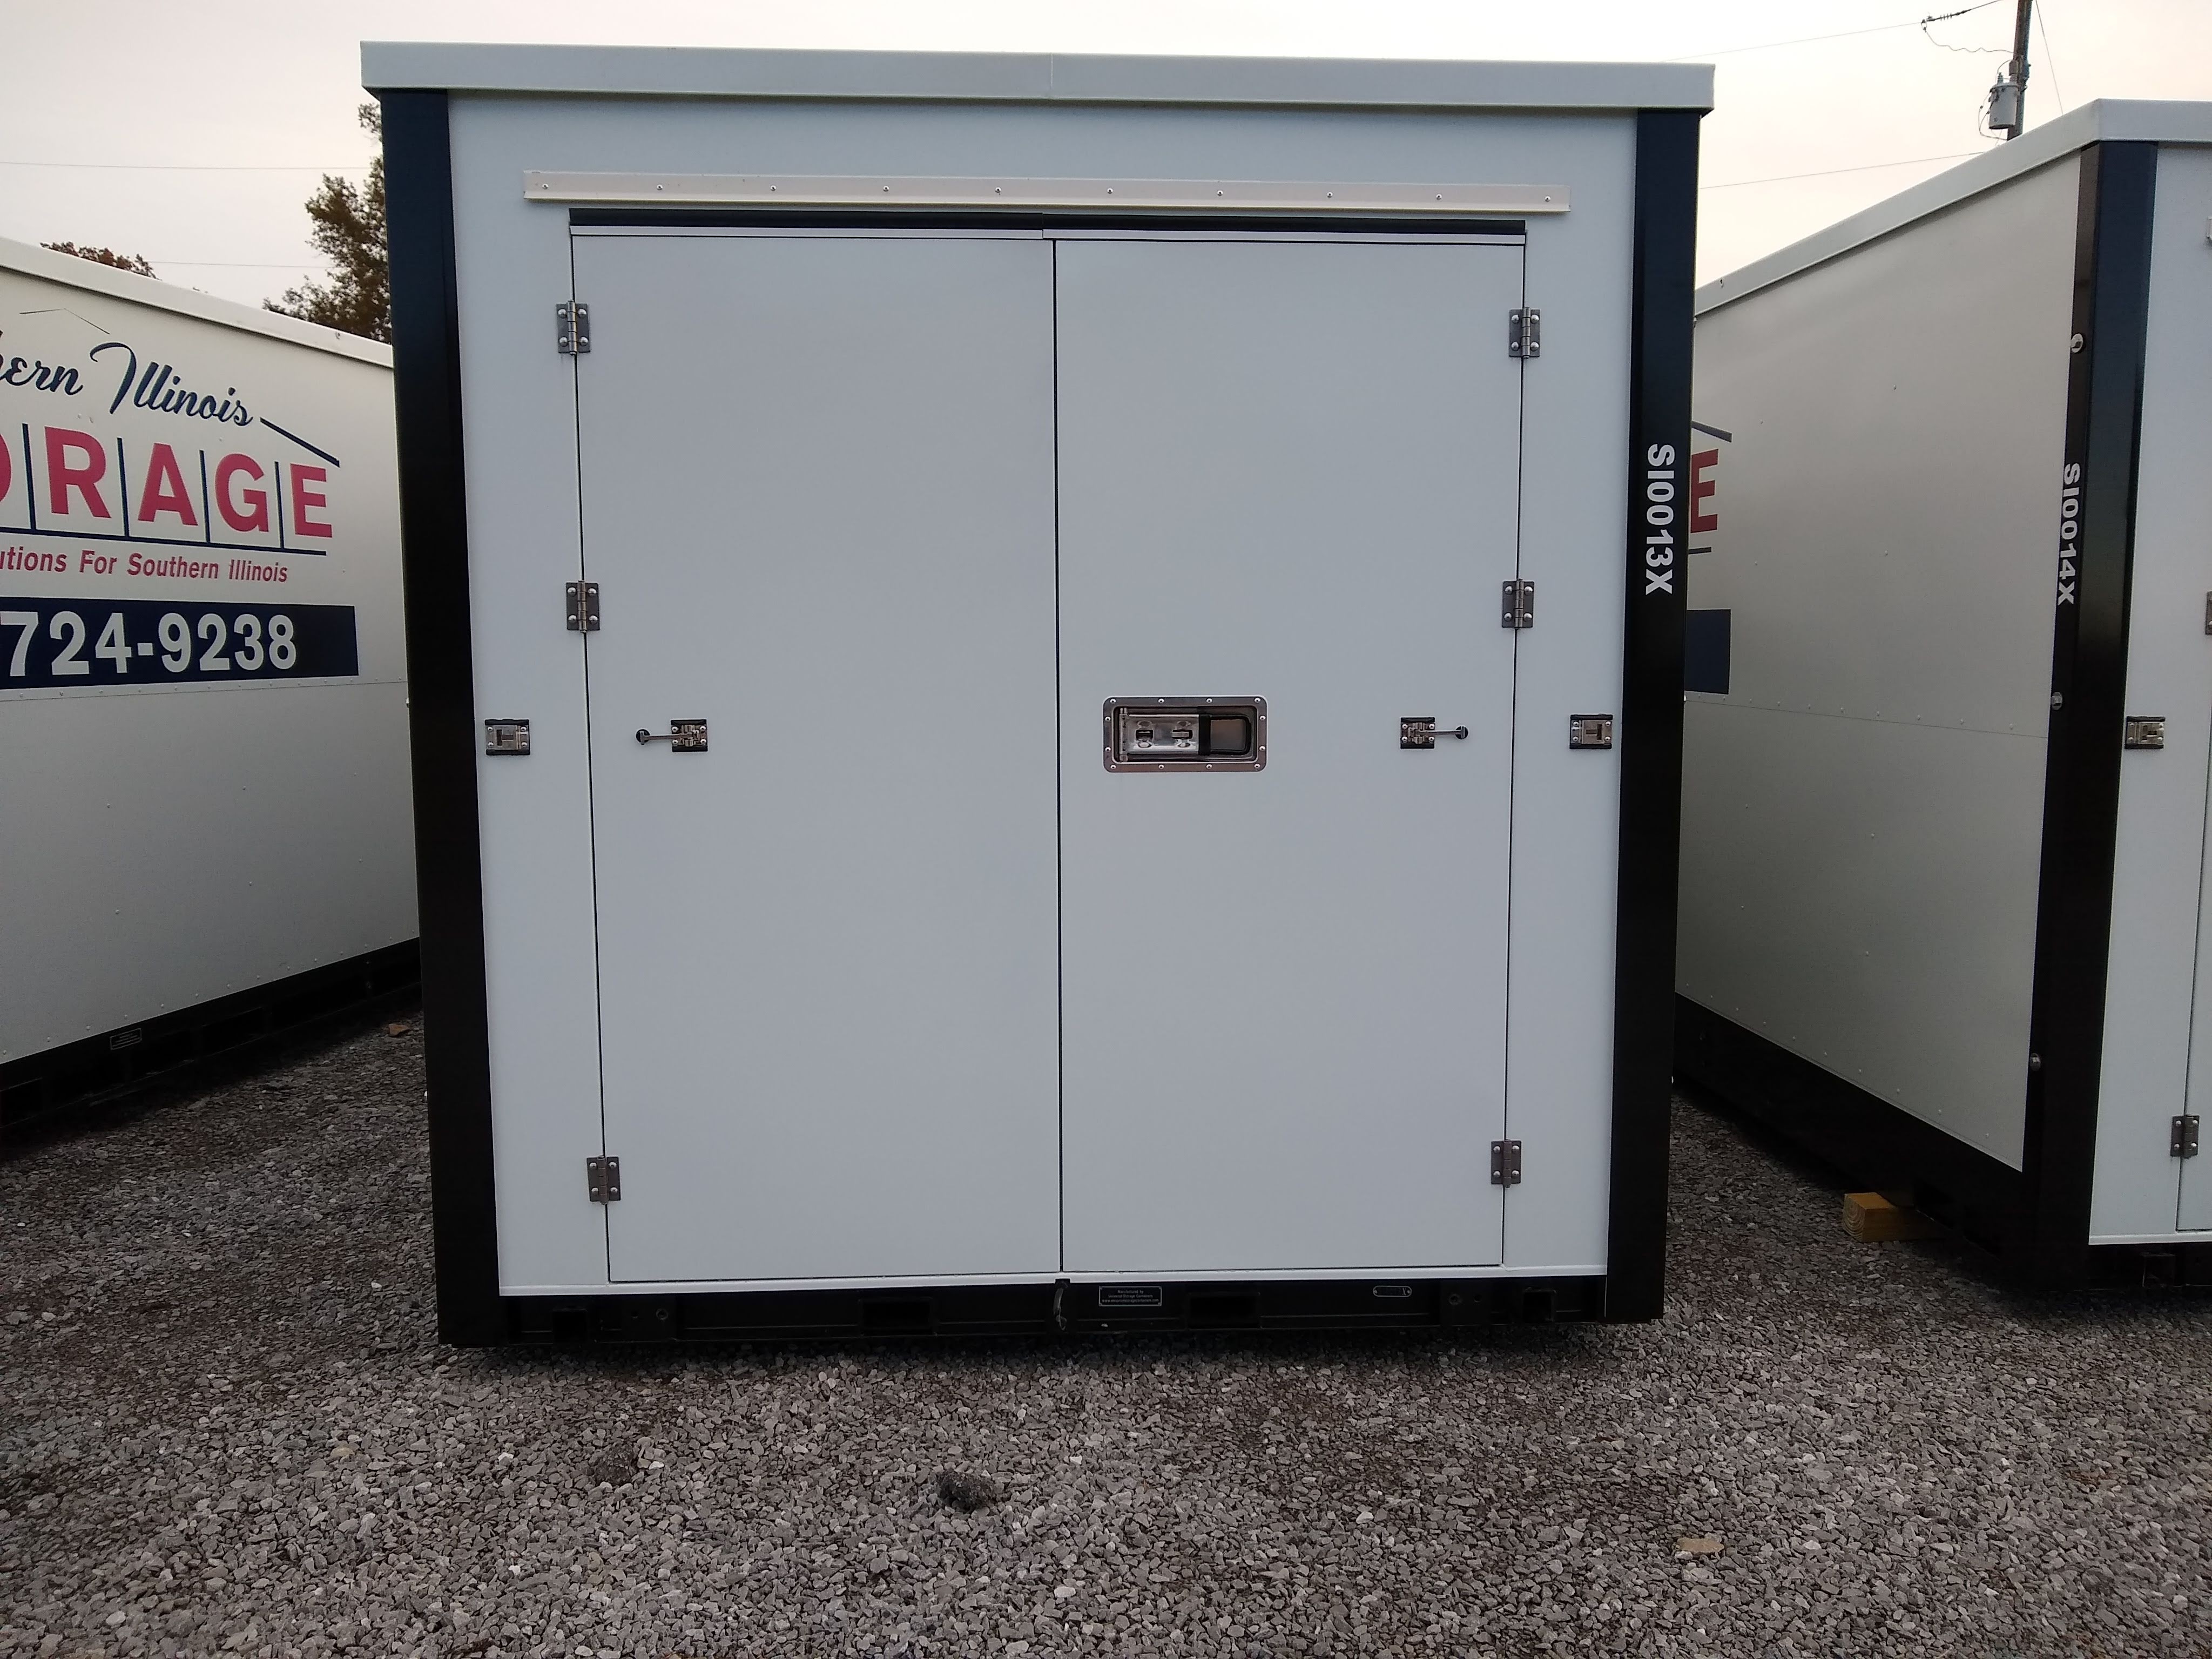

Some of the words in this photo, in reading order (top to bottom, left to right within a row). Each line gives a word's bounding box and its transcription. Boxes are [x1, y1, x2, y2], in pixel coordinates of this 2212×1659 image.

[0, 331, 83, 396] ern
[90, 342, 253, 427] Illinois
[0, 427, 333, 538] RAGE
[1646, 443, 1675, 595] SI0013X
[2058, 463, 2080, 605] SI0014X
[79, 550, 117, 574] For
[127, 552, 219, 579] Southern
[229, 559, 288, 582] Illinois
[0, 611, 297, 677] 724-9238
